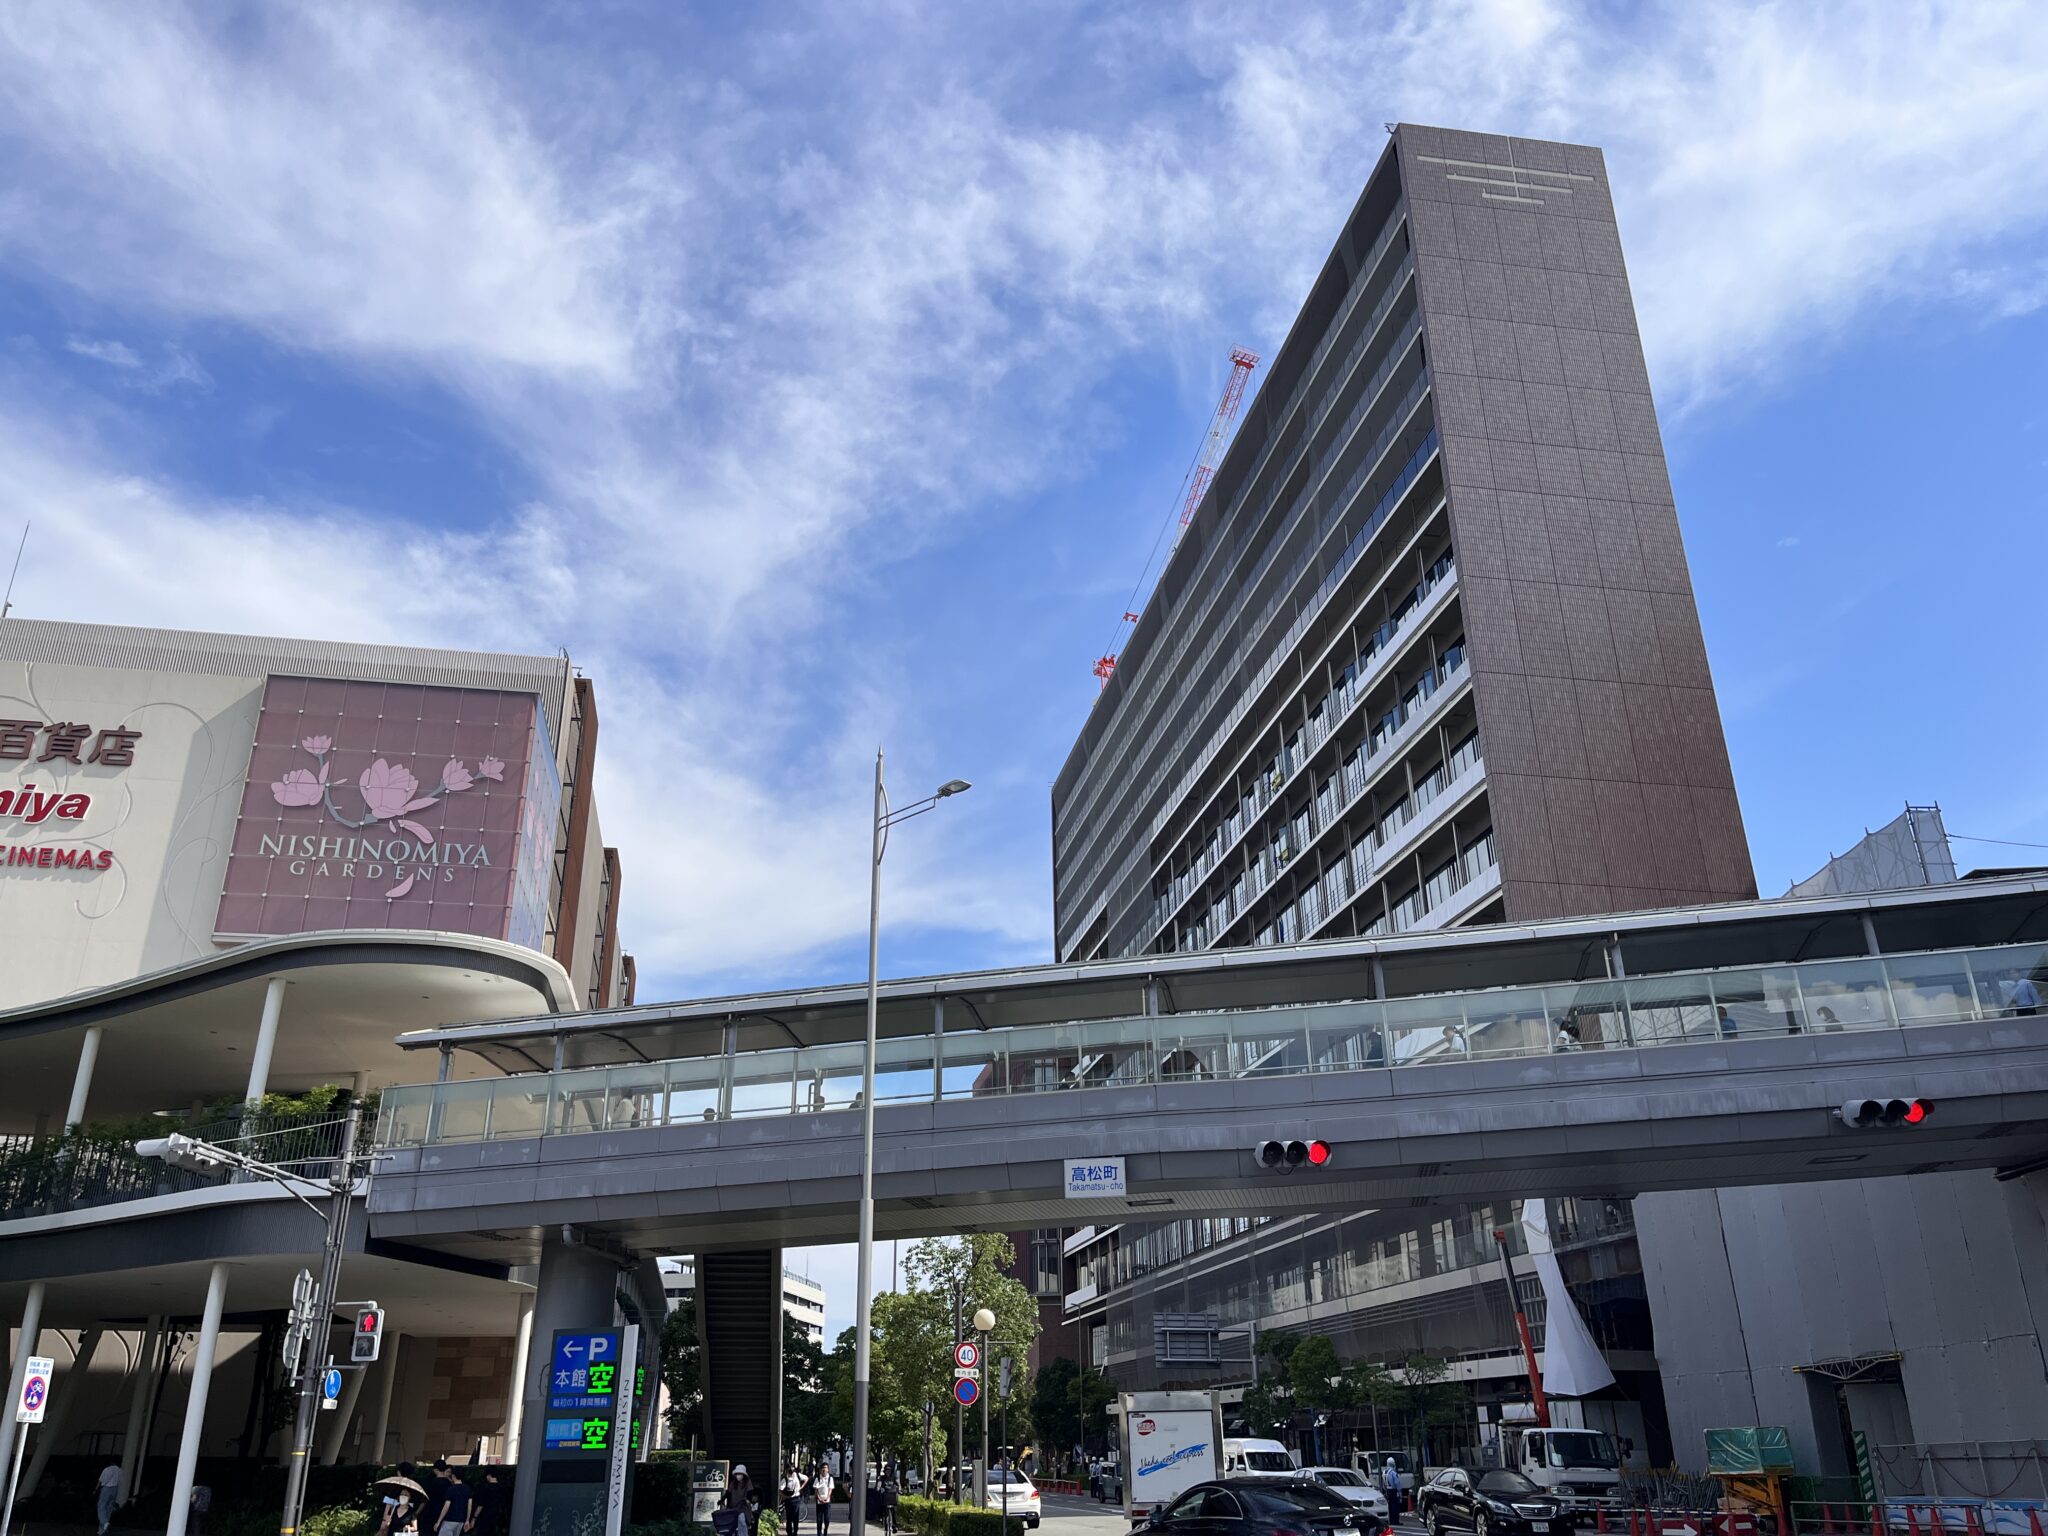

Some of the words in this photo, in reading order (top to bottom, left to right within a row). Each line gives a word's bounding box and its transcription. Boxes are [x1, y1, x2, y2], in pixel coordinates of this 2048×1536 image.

[258, 834, 491, 866] NISHINOMIYA
[290, 861, 454, 882] GARDENS
[1071, 1165, 1118, 1182] 高松町
[1068, 1182, 1124, 1191] Takamatsu-cho
[588, 1337, 608, 1360] P
[960, 1349, 973, 1361] 40
[555, 1369, 587, 1388] 本館
[587, 1363, 614, 1394] 空
[581, 1417, 609, 1449] 空
[612, 1379, 630, 1509] NISHINOMIYA
